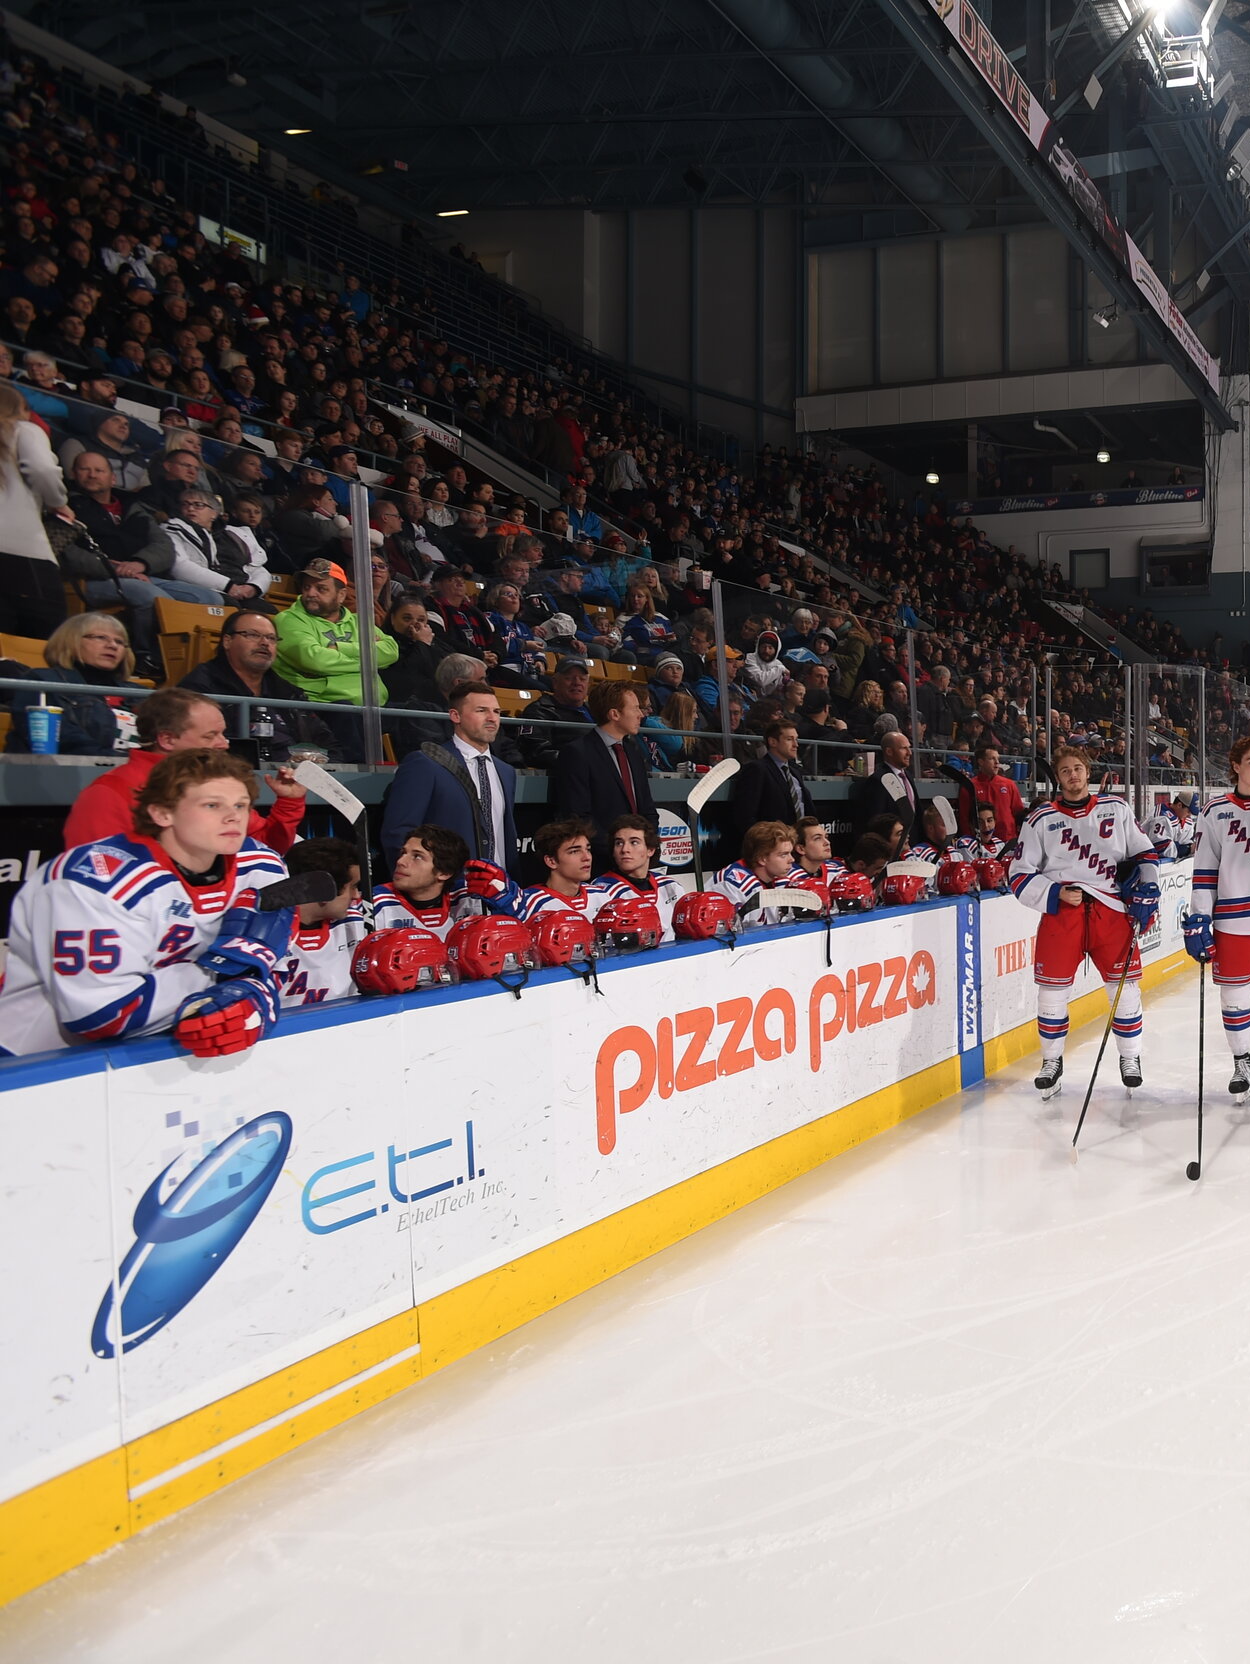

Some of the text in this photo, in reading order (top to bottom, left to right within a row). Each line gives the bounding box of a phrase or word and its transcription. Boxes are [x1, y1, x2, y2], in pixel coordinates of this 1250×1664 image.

[959, 2, 1032, 134] DRIVE
[431, 430, 442, 441] ALL
[443, 434, 458, 445] PLAY
[1136, 489, 1184, 503] Blueline
[1099, 818, 1115, 838] C
[1153, 822, 1166, 836] 31
[666, 841, 693, 849] SOUND
[54, 929, 121, 976] 55
[994, 938, 1026, 977] THE
[595, 949, 936, 1156] pizza pizza
[396, 1181, 508, 1234] EthelTech Inc.
